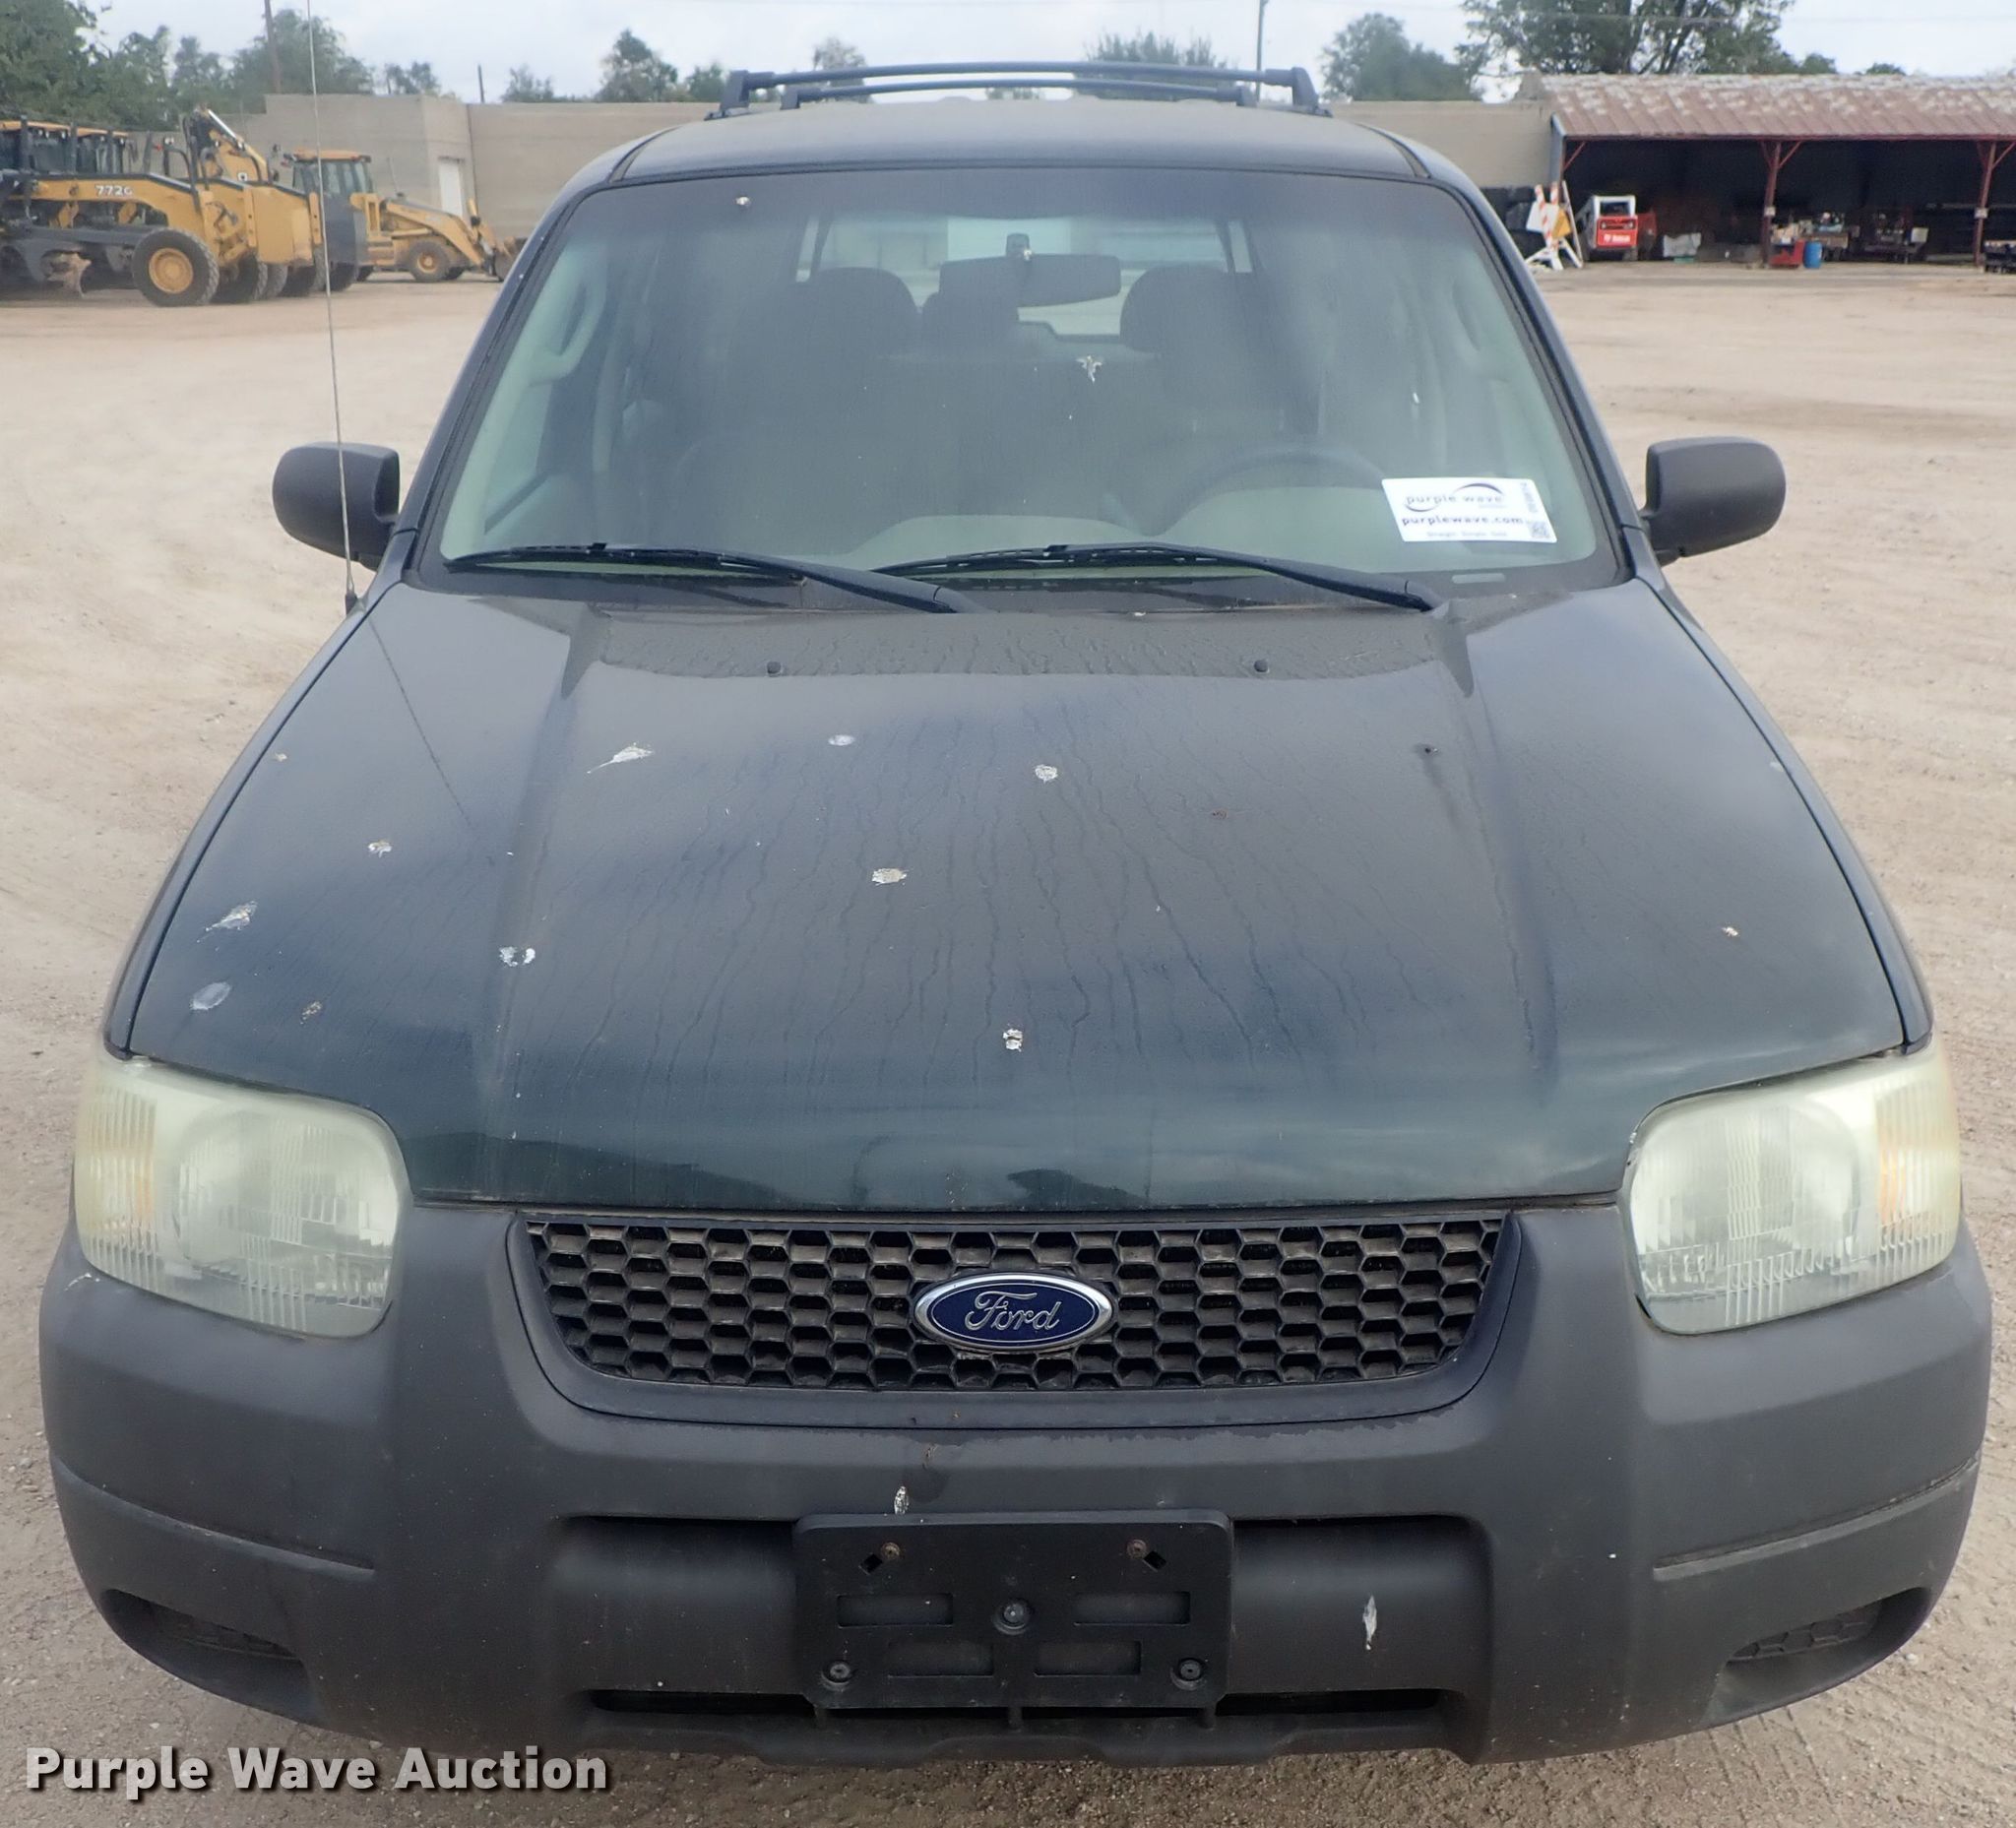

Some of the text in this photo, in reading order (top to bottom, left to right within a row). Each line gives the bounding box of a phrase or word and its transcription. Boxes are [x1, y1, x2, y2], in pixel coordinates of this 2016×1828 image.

[1406, 494, 1457, 505] purple
[1401, 515, 1524, 526] purplewave.com
[965, 1291, 1062, 1331] Ford
